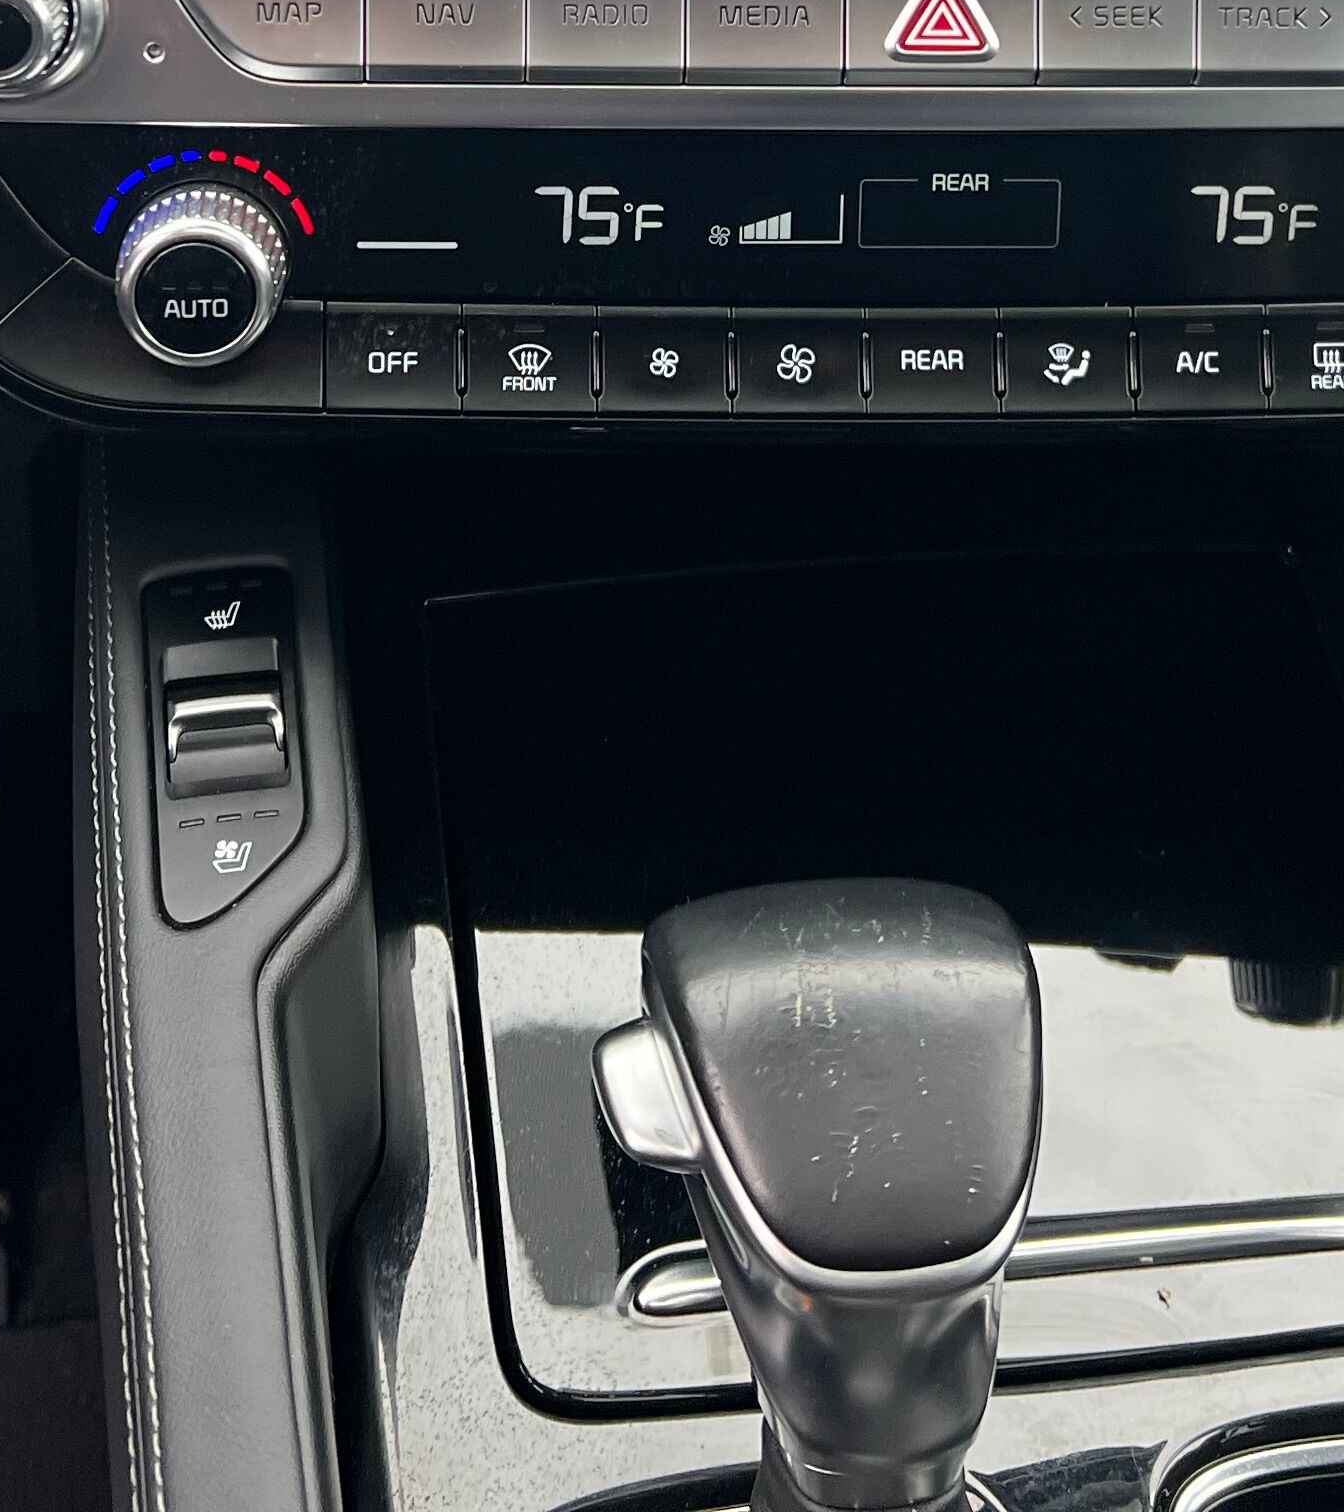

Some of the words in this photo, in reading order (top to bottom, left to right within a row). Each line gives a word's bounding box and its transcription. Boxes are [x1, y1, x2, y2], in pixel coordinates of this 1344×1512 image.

[256, 0, 323, 25] MAP
[415, 1, 477, 26] NAV
[562, 3, 650, 27] RADIO
[717, 4, 811, 28] MEDIA
[1091, 4, 1165, 29] SEEK
[1218, 4, 1311, 30] TRACK
[931, 172, 990, 192] REAR
[164, 298, 230, 320] AUTO
[367, 351, 419, 375] OFF
[900, 349, 964, 372] REAR
[1175, 350, 1220, 375] A/C
[502, 376, 557, 393] FRONT
